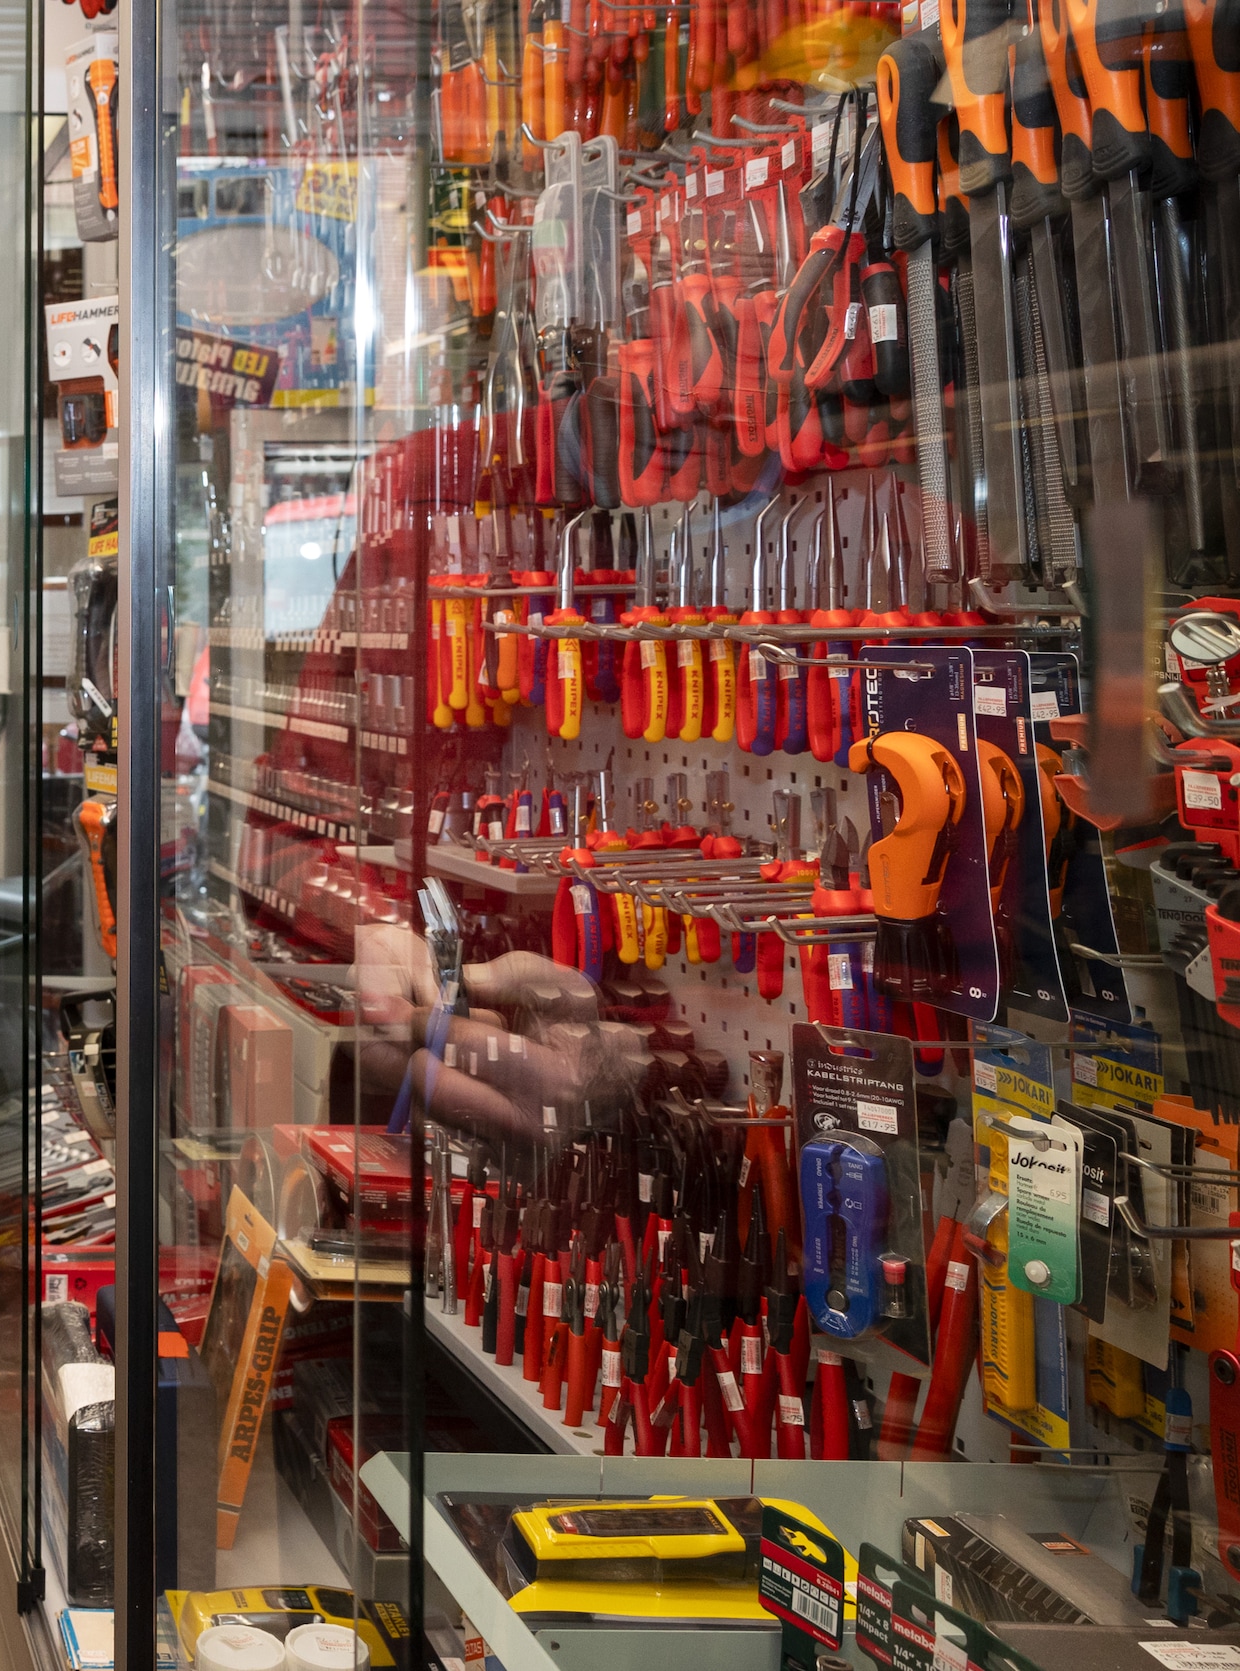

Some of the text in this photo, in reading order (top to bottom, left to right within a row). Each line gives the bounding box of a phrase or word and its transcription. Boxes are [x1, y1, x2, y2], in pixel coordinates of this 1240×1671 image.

[455, 636, 463, 681] KNIPEX
[656, 671, 664, 720] KNIPEX
[691, 669, 699, 719] KNIPEX
[723, 669, 731, 719] KNIPEX
[1018, 718, 1026, 752] PREMIUM
[621, 892, 633, 940] KNIPEX
[806, 1069, 904, 1092] KABELSTRIPTANG
[1013, 1075, 1050, 1106] JOKARI
[1111, 1064, 1158, 1092] JOKARI
[989, 1302, 1000, 1348] JOKARI
[858, 1579, 892, 1608] metabo
[857, 1614, 889, 1643] Impact
[882, 1620, 890, 1631] 8
[894, 1621, 935, 1651] metabo
[465, 1640, 483, 1657] ELTAS
